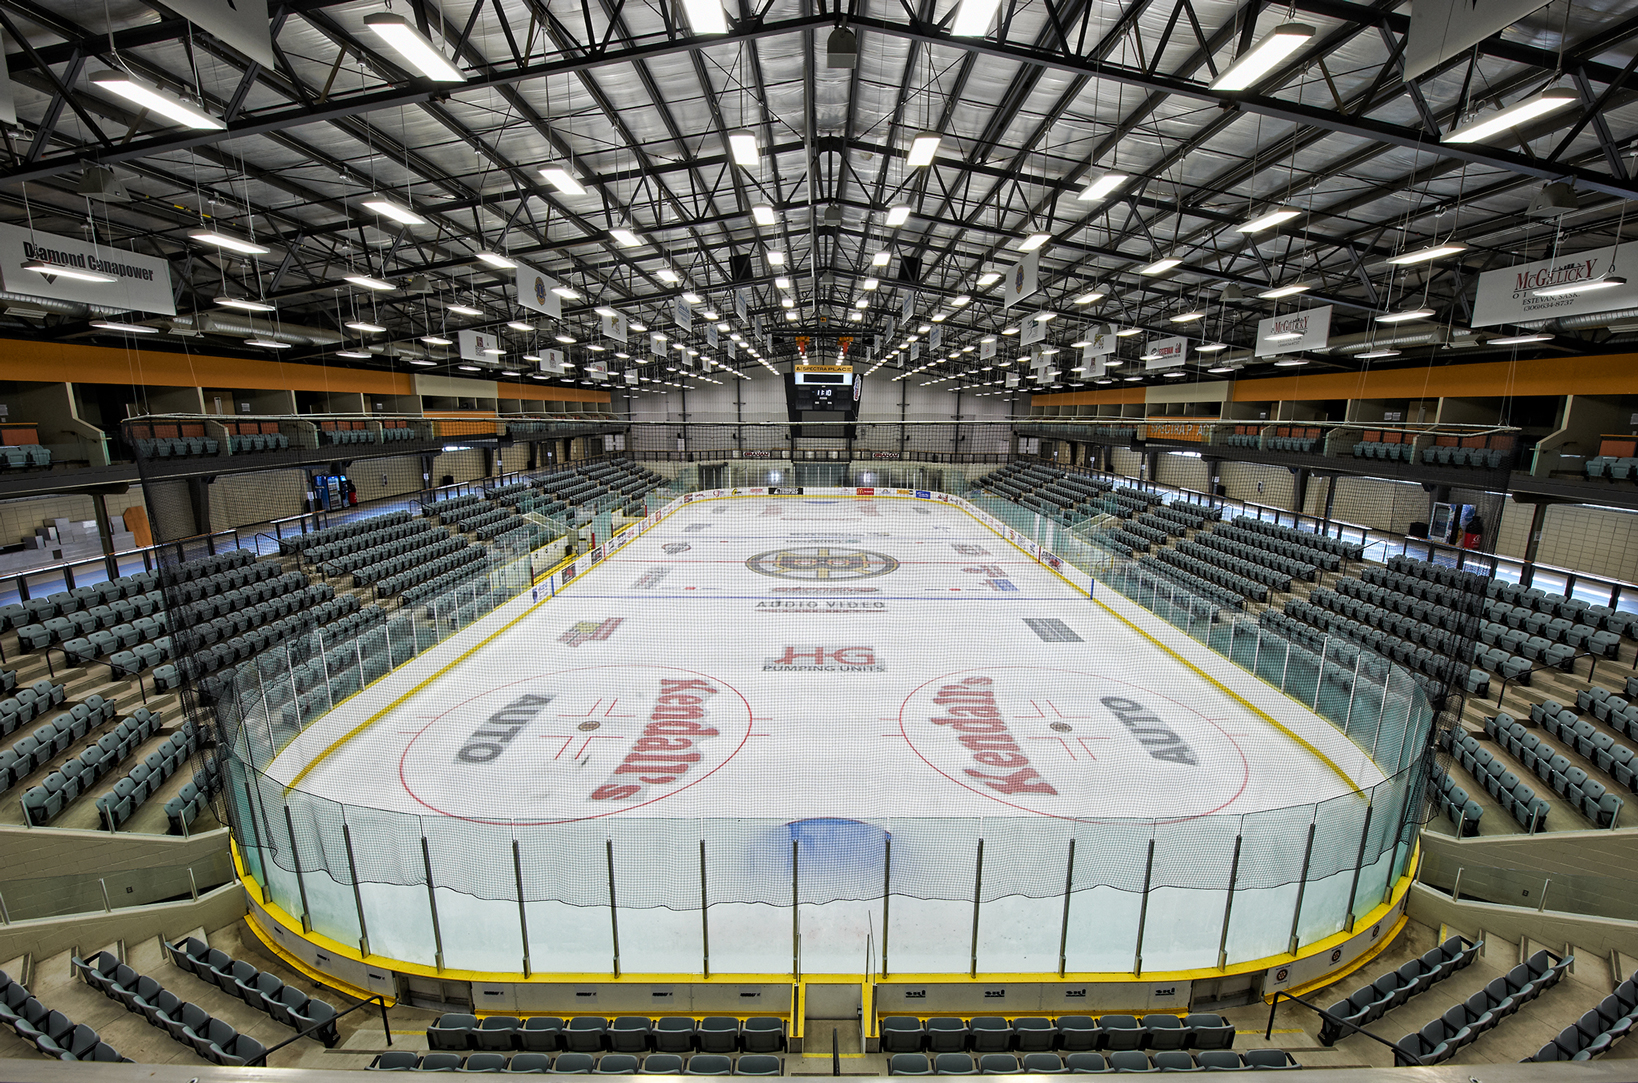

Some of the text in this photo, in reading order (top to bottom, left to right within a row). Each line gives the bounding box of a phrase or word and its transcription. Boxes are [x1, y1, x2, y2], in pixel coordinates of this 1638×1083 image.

[22, 240, 87, 268] Diamond
[1151, 424, 1185, 436] SPECTRA
[827, 601, 885, 609] VIDEO
[457, 694, 552, 764] AUTO
[591, 678, 720, 801] Kendall's
[929, 676, 1058, 796] Kendall's
[1100, 696, 1196, 766] AUTO
